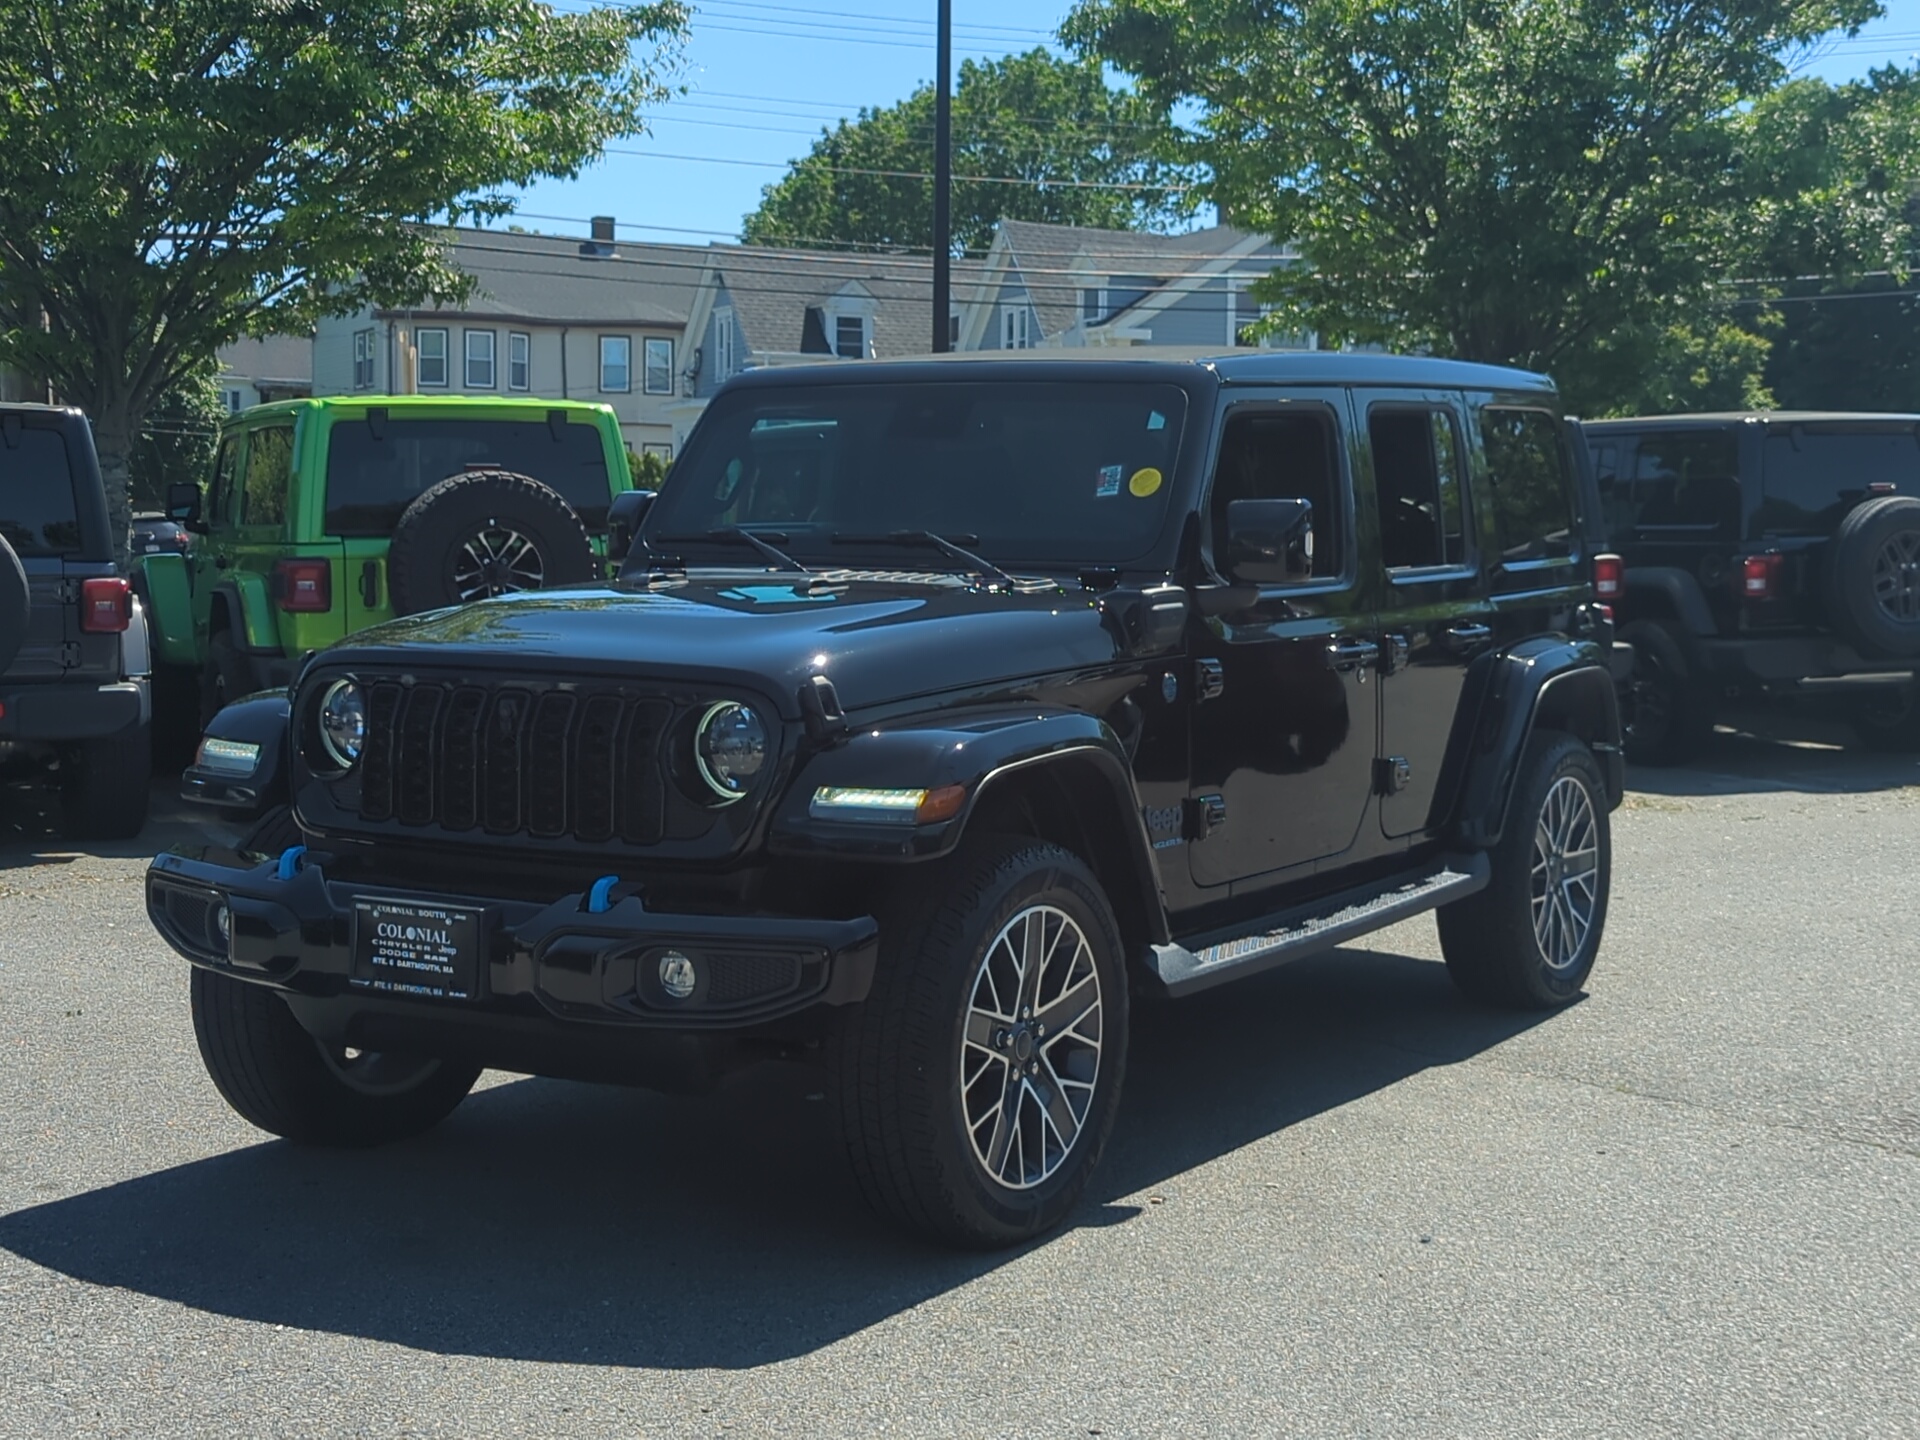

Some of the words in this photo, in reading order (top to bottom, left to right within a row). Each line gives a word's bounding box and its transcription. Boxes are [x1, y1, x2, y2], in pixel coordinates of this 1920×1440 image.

[418, 910, 446, 919] SOUTH
[377, 922, 451, 944] COLONIAL
[371, 938, 431, 951] CHRYSLER
[438, 945, 457, 956] Jeep
[379, 948, 416, 959] DODGE
[424, 954, 448, 962] RAM
[443, 965, 454, 974] MA
